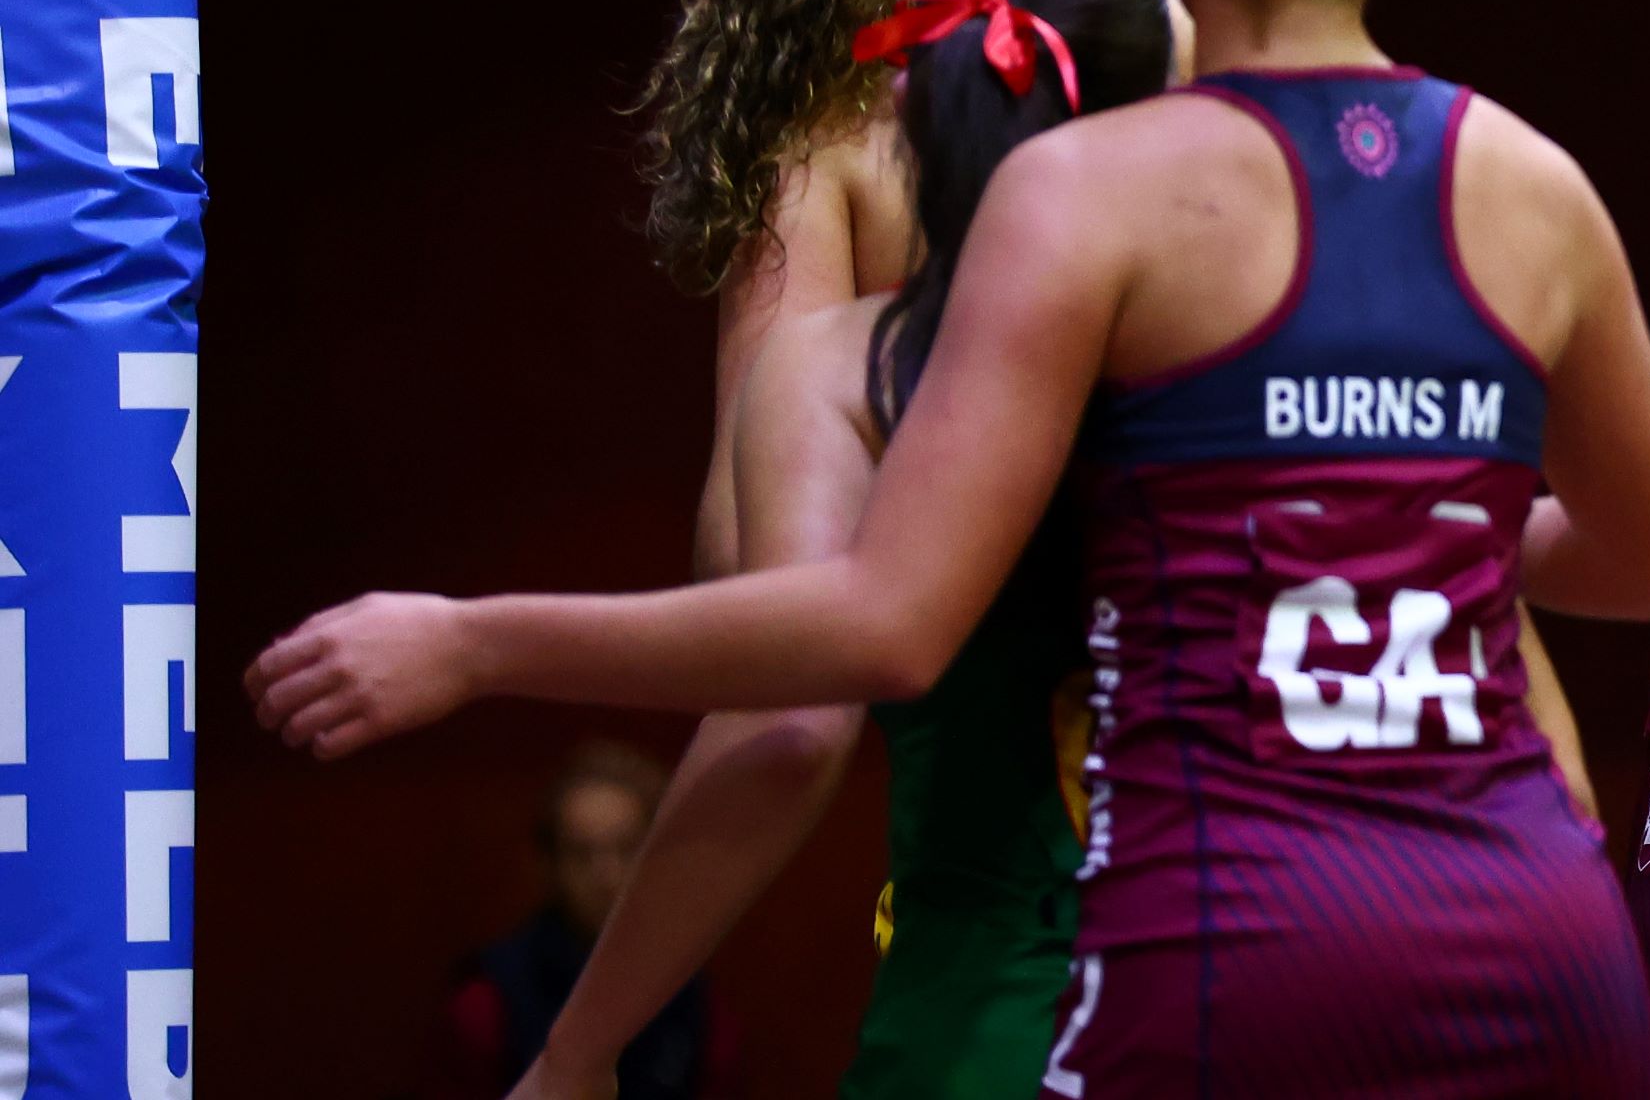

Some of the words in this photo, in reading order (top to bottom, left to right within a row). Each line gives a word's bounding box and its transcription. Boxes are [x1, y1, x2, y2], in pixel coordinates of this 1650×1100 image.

[1265, 377, 1445, 439] BURNS
[1458, 379, 1504, 441] M
[1257, 576, 1485, 750] GA
